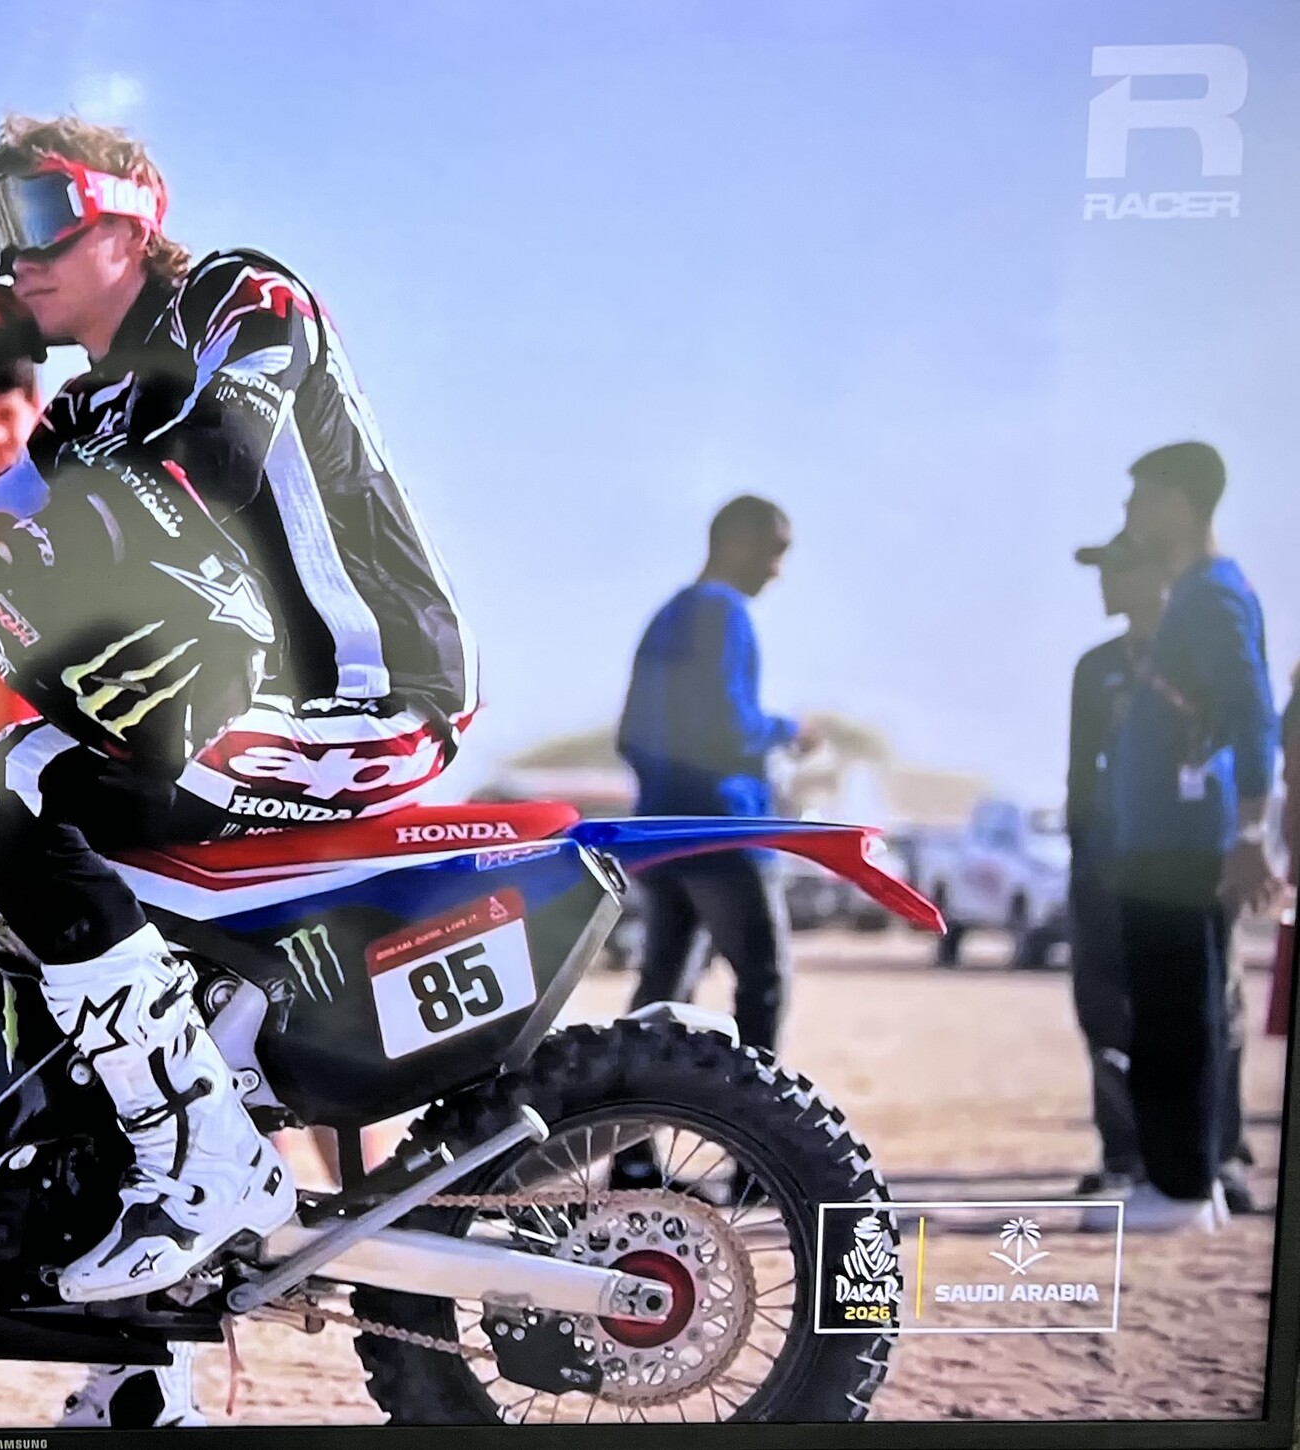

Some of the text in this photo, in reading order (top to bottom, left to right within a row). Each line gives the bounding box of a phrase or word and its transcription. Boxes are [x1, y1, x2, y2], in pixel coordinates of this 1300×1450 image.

[1083, 191, 1241, 220] RACER
[228, 795, 352, 822] HONDA
[396, 822, 518, 844] HONDA
[408, 942, 504, 1034] 85
[835, 1275, 901, 1304] DAKAR
[935, 1283, 1100, 1302] SAUDI ARABIA
[844, 1305, 891, 1321] 2026
